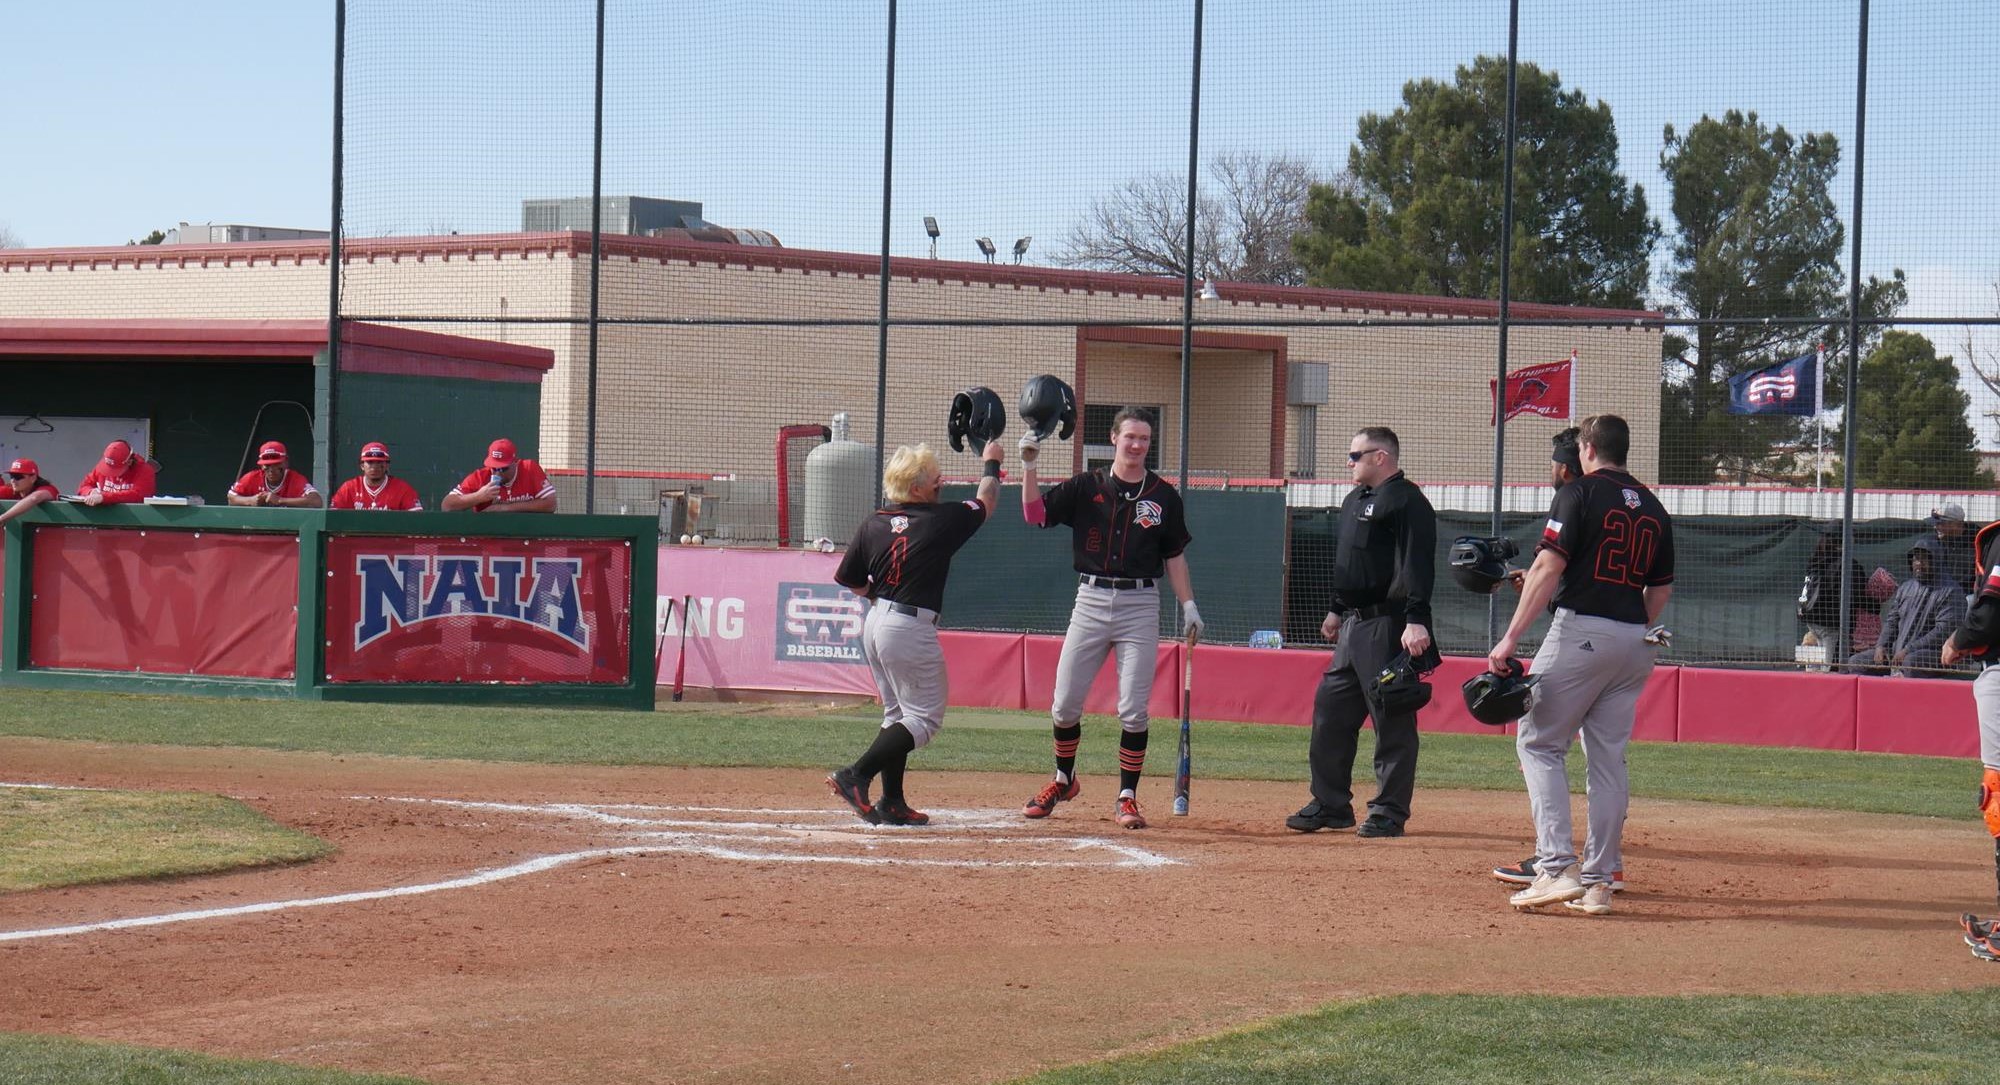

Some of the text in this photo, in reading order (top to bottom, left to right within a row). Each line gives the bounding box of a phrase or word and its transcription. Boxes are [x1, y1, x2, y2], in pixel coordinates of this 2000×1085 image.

[886, 535, 908, 586] 1
[1594, 508, 1662, 588] 20
[354, 554, 589, 652] NAIA
[786, 644, 861, 659] BASEBALL
